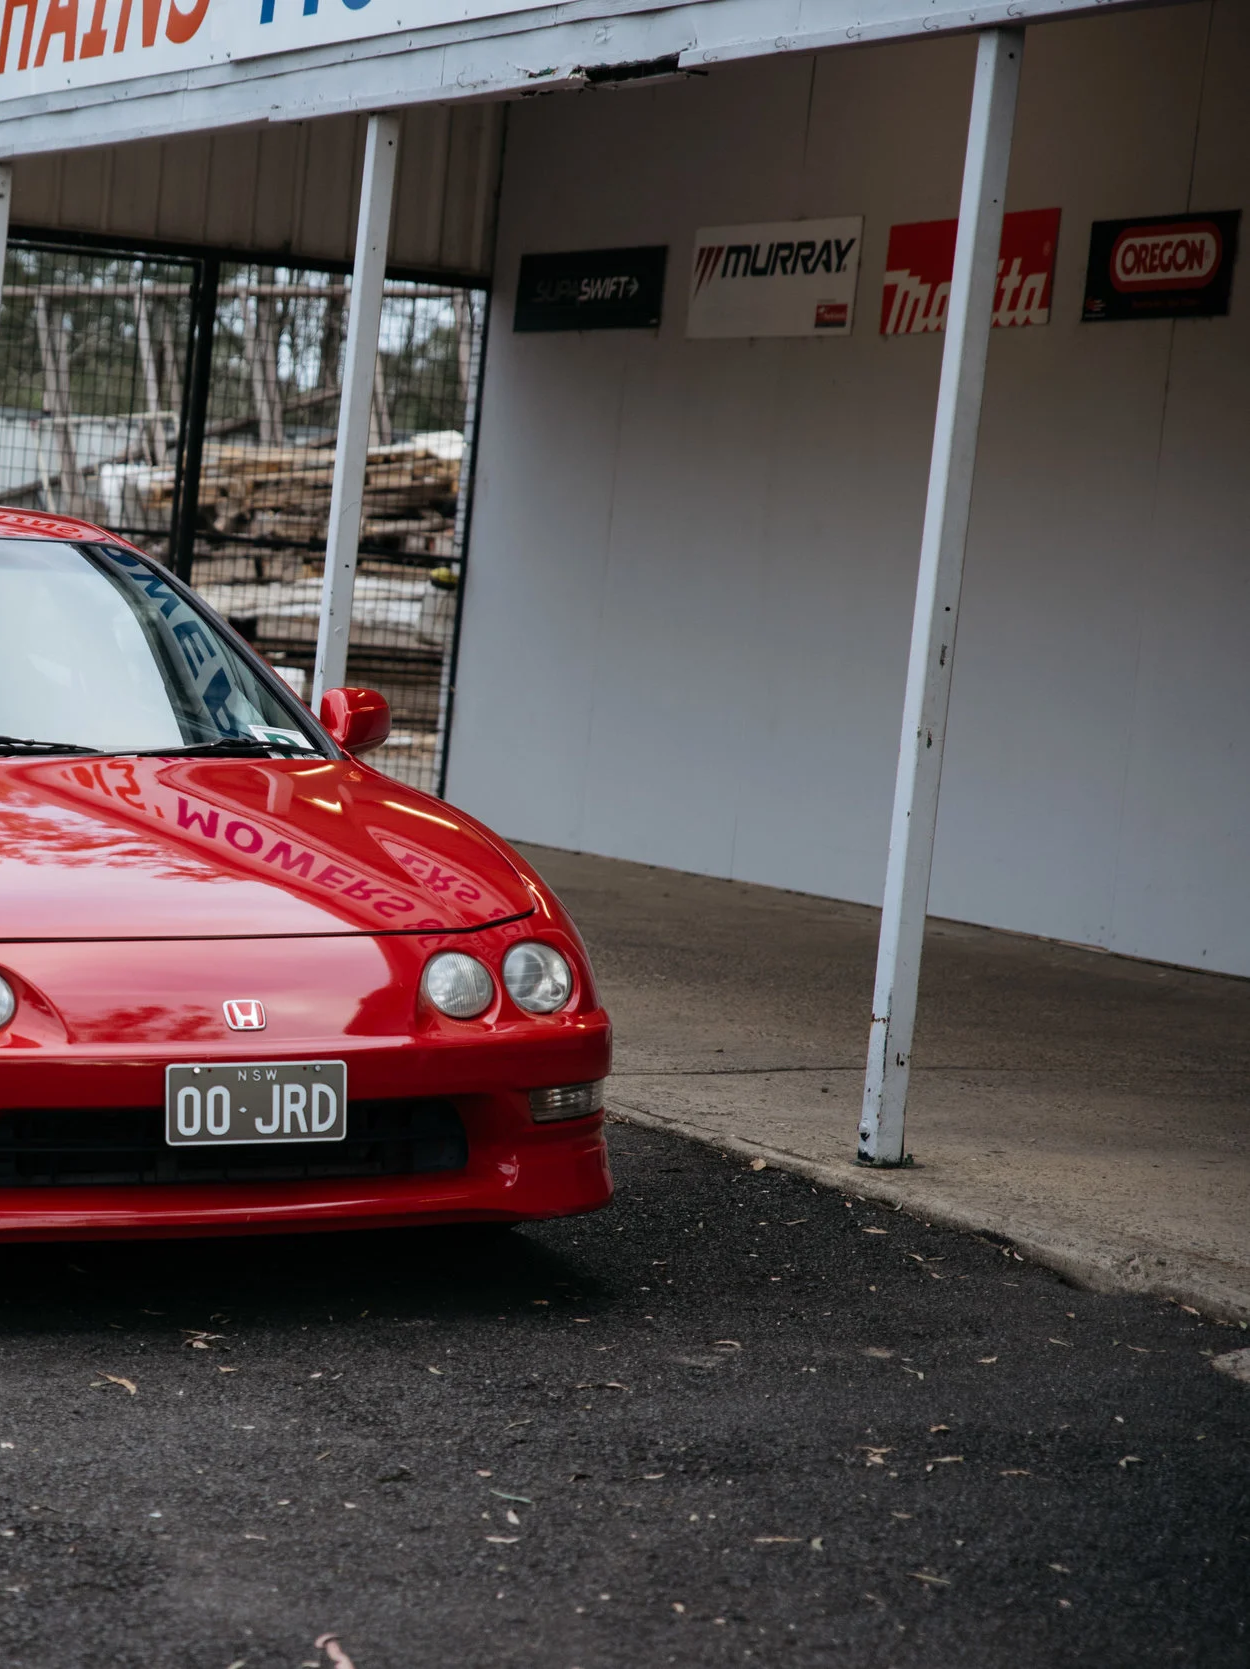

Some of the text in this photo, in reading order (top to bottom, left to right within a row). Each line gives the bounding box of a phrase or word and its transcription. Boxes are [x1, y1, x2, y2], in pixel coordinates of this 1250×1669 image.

[721, 238, 857, 278] MURRAY
[1120, 239, 1206, 275] OREGON
[882, 257, 1050, 335] Mata
[237, 1069, 278, 1081] NSW
[254, 1082, 338, 1134] JRD
